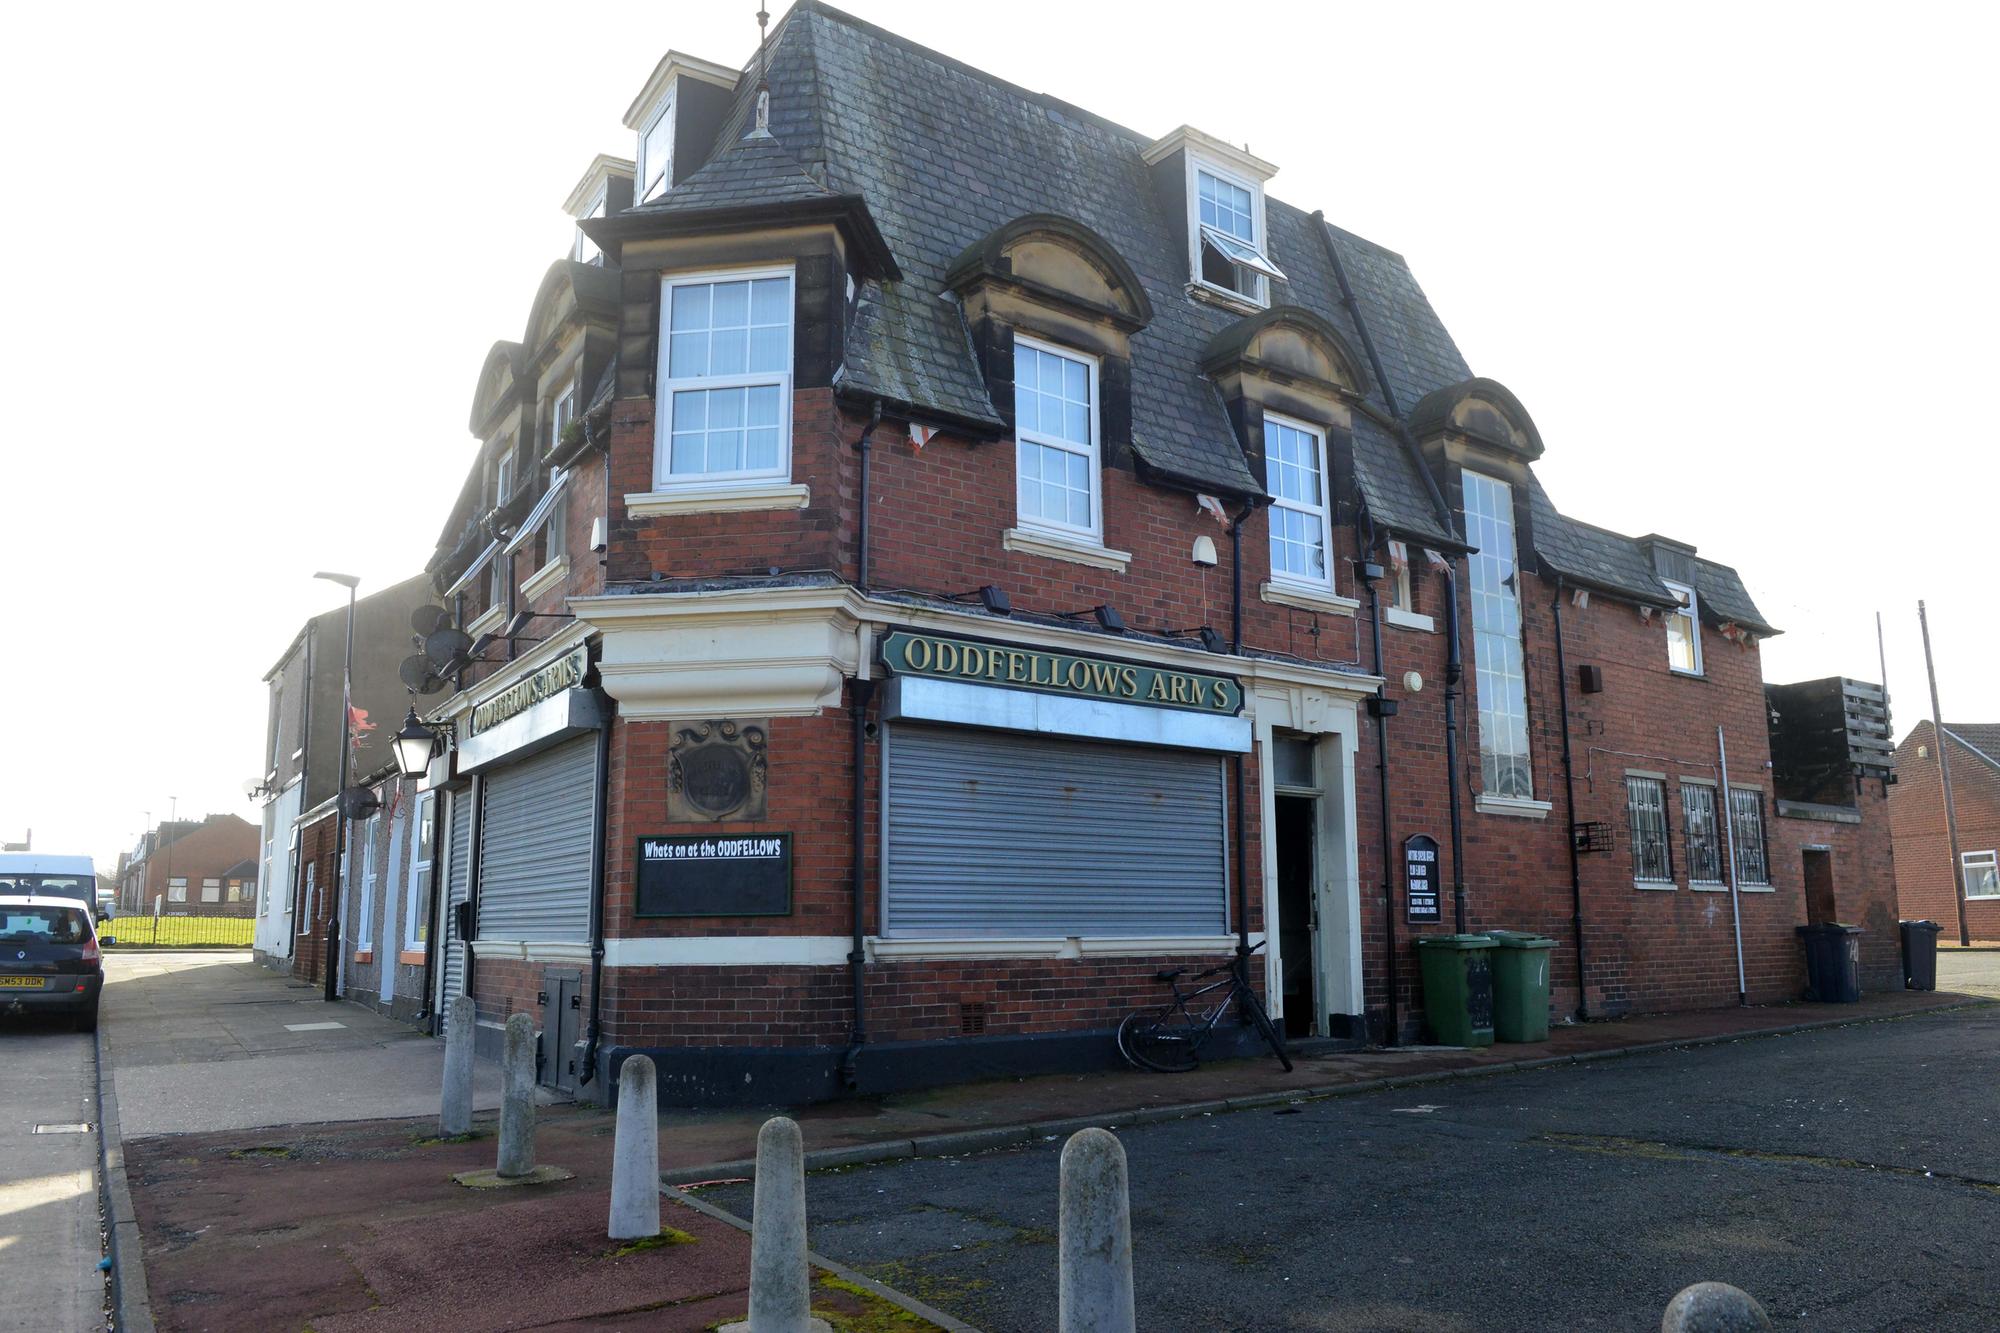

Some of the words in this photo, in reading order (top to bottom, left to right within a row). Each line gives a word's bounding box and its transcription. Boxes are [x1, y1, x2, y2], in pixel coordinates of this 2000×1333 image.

[905, 638, 1138, 697] ODDFELLOWS
[1147, 674, 1229, 708] ARMS
[644, 841, 673, 858] Whats
[675, 844, 686, 858] on
[688, 843, 698, 857] at
[700, 840, 716, 857] the
[717, 838, 781, 857] ODDFELLOWS
